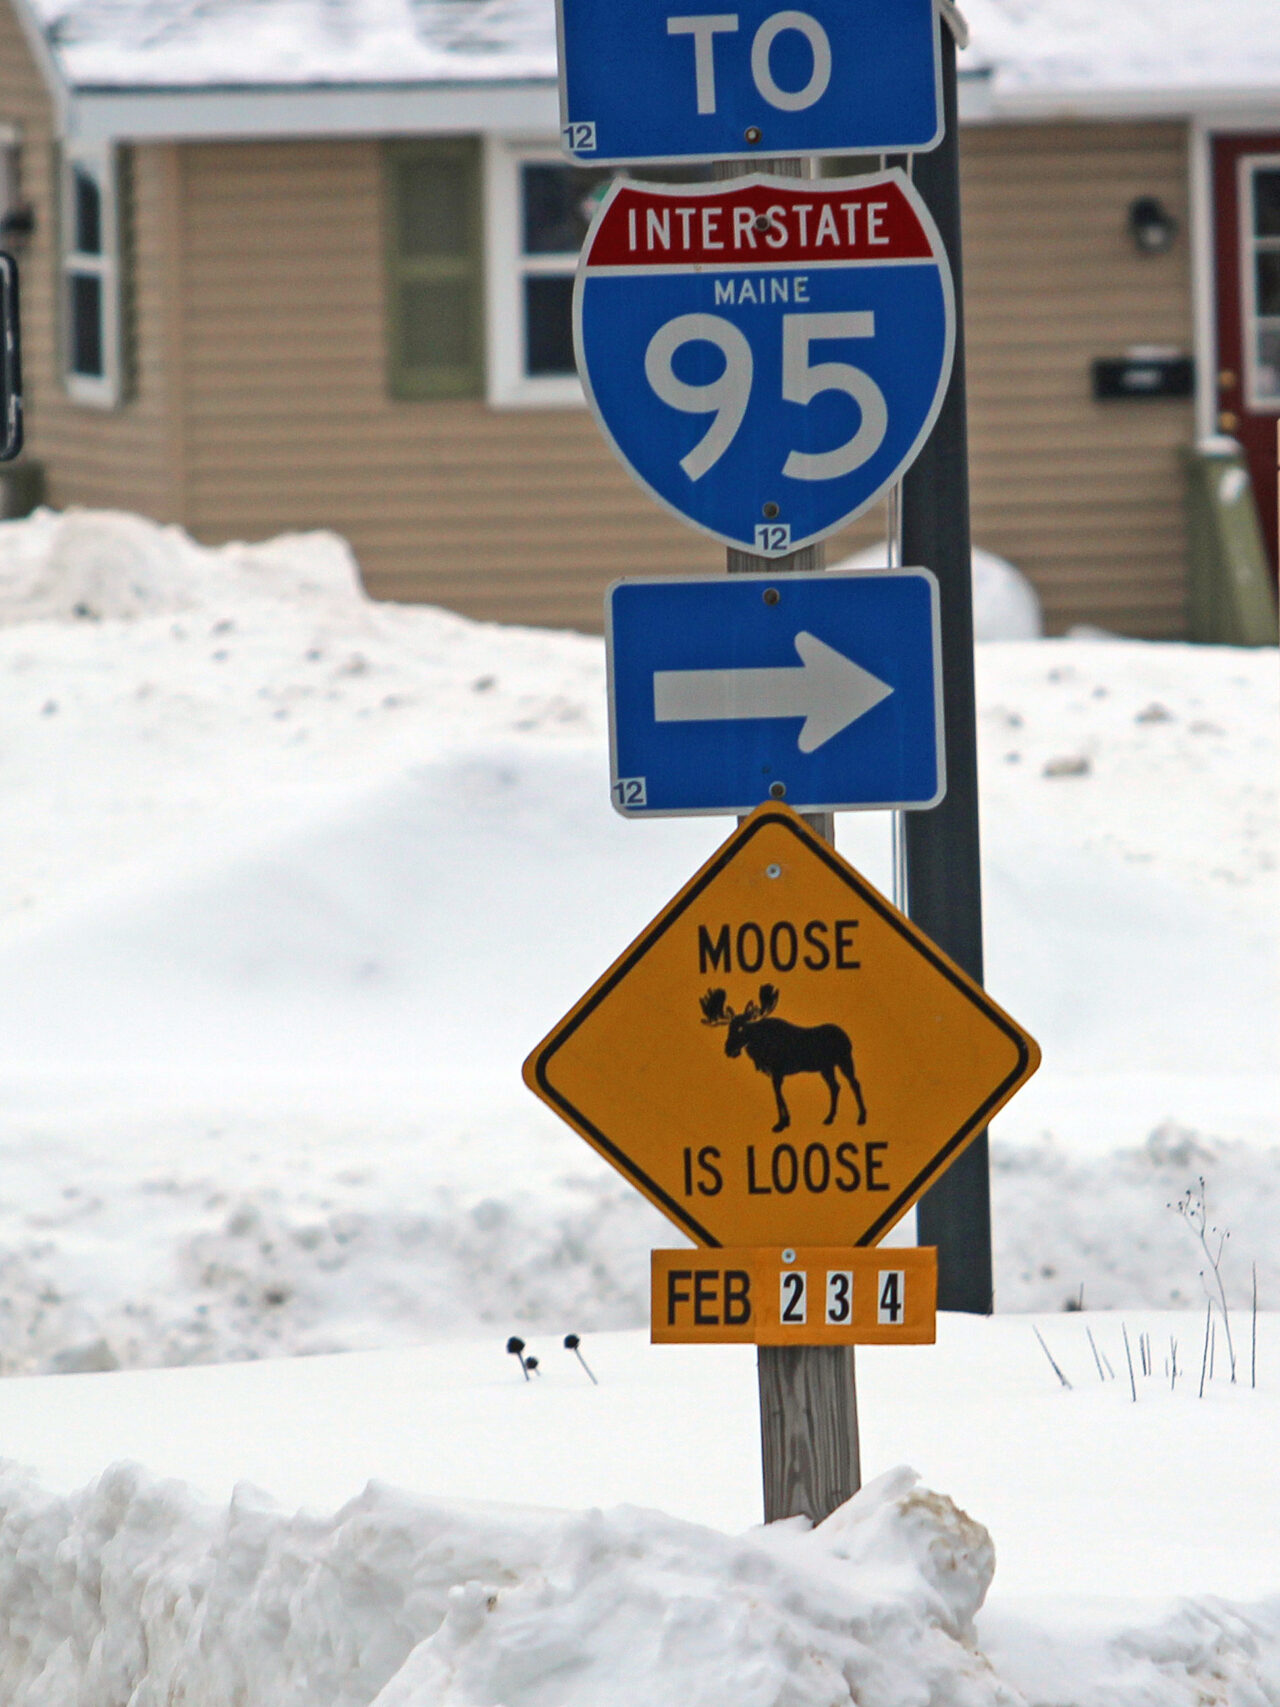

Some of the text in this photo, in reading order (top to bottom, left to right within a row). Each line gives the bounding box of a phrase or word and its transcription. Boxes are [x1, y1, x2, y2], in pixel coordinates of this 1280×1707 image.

[666, 10, 832, 115] TO
[563, 124, 594, 149] 12
[628, 202, 890, 251] INTERSTATE
[714, 276, 811, 306] MAINE
[644, 310, 889, 482] 95
[757, 526, 788, 551] 12
[613, 781, 644, 804] 12
[698, 920, 861, 974] MOOSE
[683, 1141, 890, 1197] IS LOOSE
[667, 1269, 752, 1326] FEB
